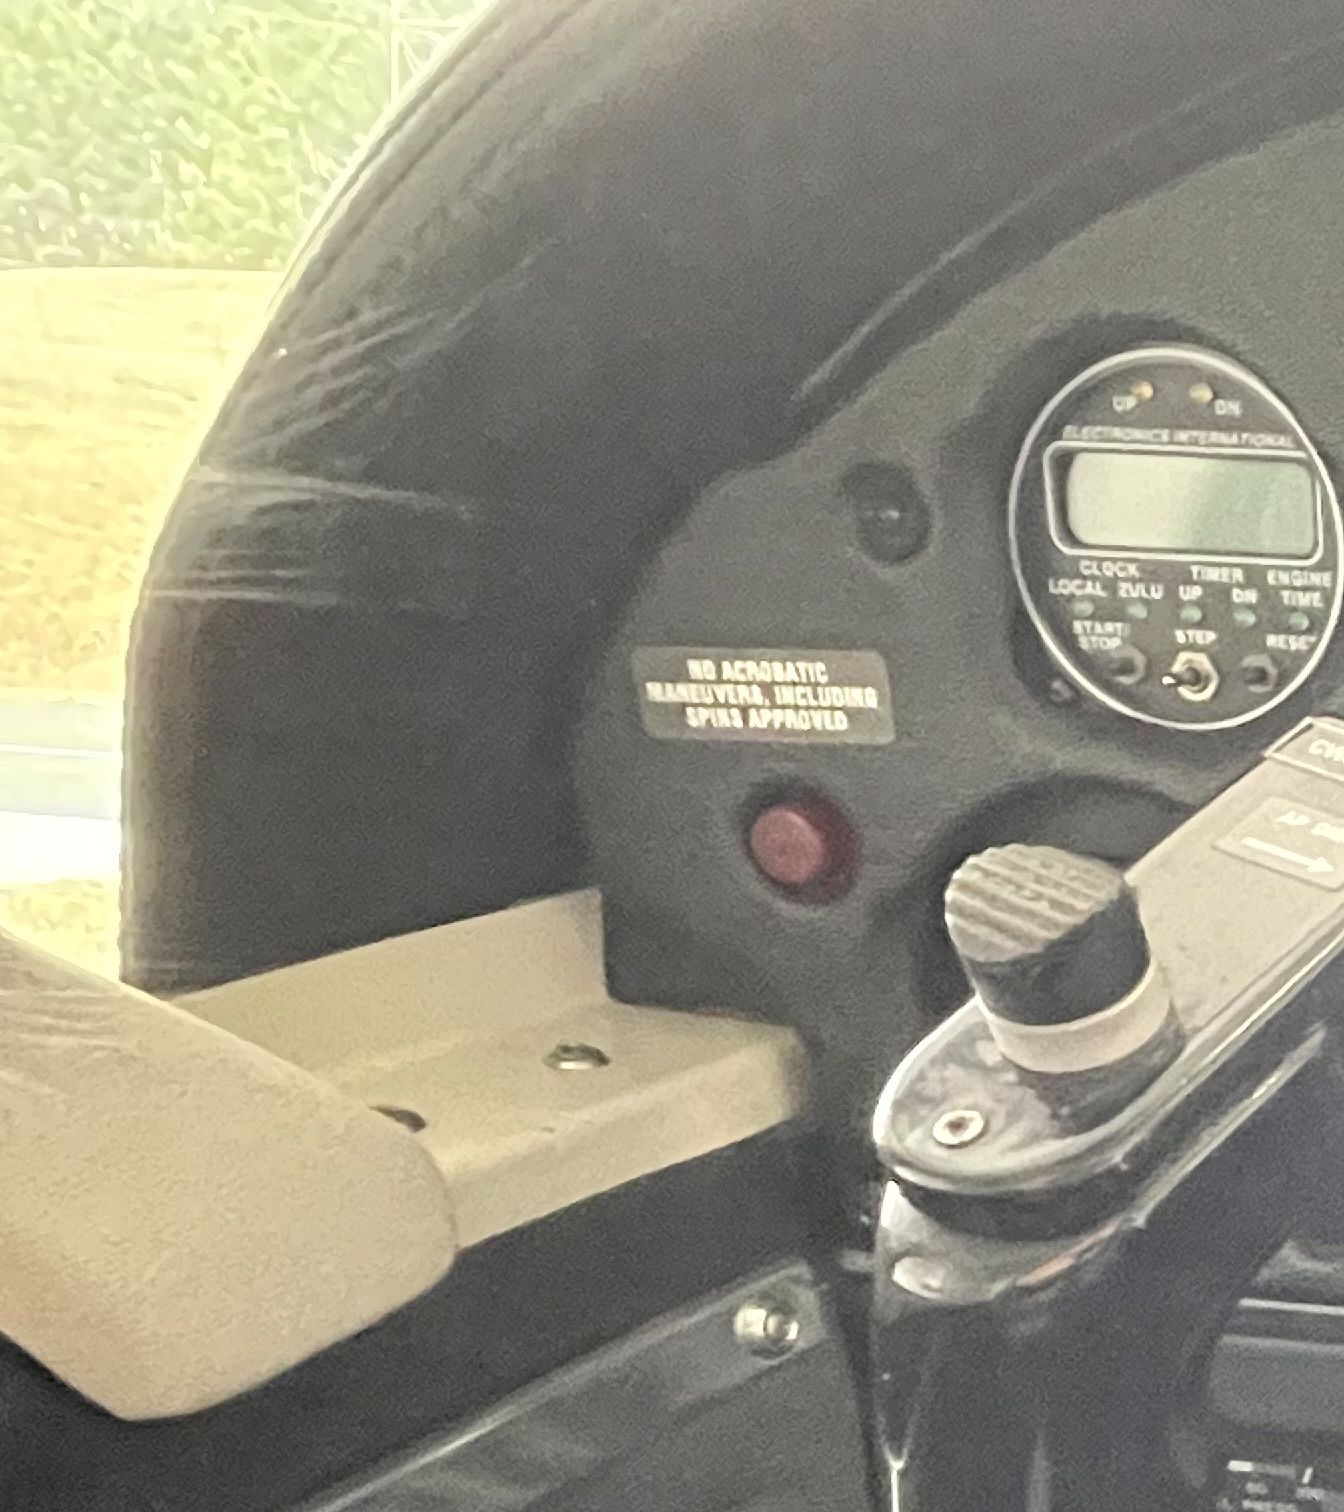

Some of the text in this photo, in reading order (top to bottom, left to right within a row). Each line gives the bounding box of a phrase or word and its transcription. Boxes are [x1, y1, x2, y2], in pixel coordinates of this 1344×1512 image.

[1215, 399, 1241, 416] DN
[1079, 560, 1139, 577] CLOCK
[1191, 565, 1244, 584] TIMER
[1267, 570, 1333, 588] ENGINE
[1050, 578, 1164, 600] LOCAL ZULU
[1179, 584, 1203, 600] UP
[1280, 590, 1325, 607] TIME
[1175, 629, 1218, 645] STEP
[687, 659, 829, 684] NO ACROBATIC
[774, 686, 878, 709] INCLUDING
[685, 706, 849, 731] SPINS APPROVED
